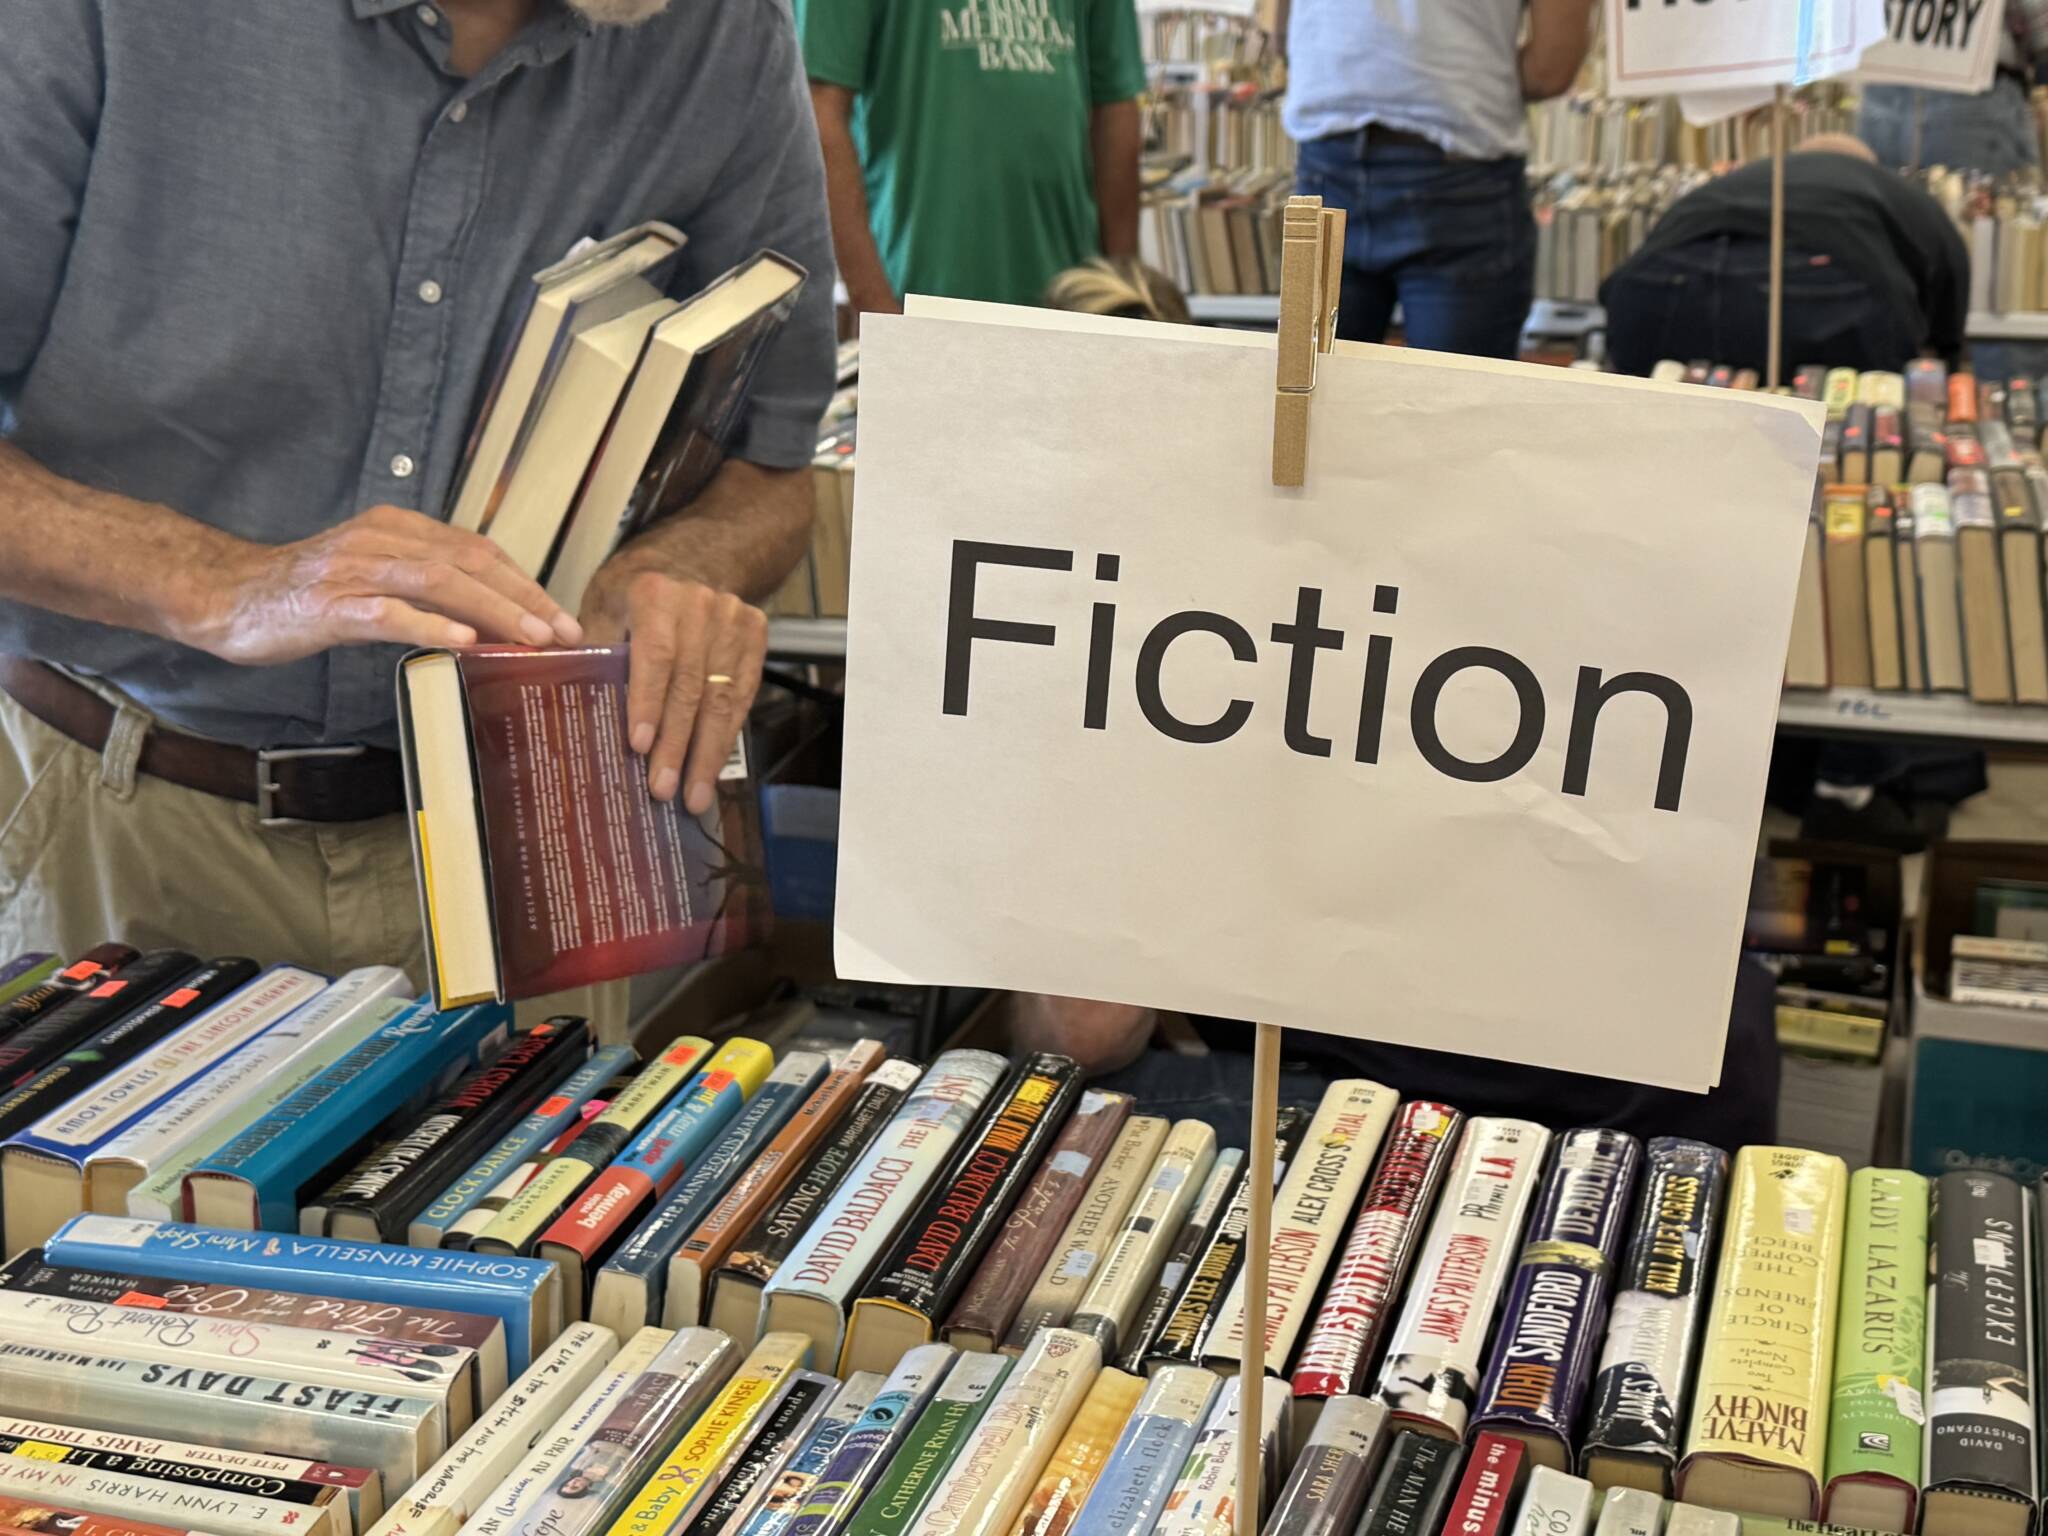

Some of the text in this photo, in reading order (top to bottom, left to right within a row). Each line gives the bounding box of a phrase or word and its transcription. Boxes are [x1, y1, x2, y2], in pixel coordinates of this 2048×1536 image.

[941, 538, 1695, 813] Fiction
[102, 1067, 160, 1108] TOWLES
[173, 1034, 204, 1059] THE
[344, 1154, 404, 1198] JAMES
[378, 1113, 464, 1168] PATTERSON
[452, 1066, 518, 1109] WORST
[500, 1035, 555, 1065] CASE
[641, 1094, 709, 1166] april may &
[983, 1114, 1034, 1153] WALK
[1004, 1098, 1044, 1125] THE
[1134, 1122, 1152, 1144] Pat
[427, 1067, 599, 1219] CLOCK DANCE TYLER
[509, 1066, 673, 1223] MUSKE-DUKES MARK TWAIN
[676, 1134, 743, 1209] MANNEQUIN
[735, 1096, 776, 1146] MAKERS
[768, 1182, 823, 1239] SAVING
[807, 1146, 849, 1188] HOPE
[840, 1107, 876, 1151] MARGARET
[869, 1086, 895, 1115] DALEY
[1110, 1136, 1143, 1171] Barker
[793, 1224, 859, 1285] DAVID
[839, 1156, 914, 1233] BALDACCI
[897, 1121, 931, 1151] THE
[924, 1075, 975, 1131] INCENT
[946, 1149, 1010, 1224] BALDACCI
[1661, 1174, 1700, 1223] CROSS
[576, 1182, 632, 1230] robin benway
[1074, 1176, 1122, 1243] ANOTHER
[1292, 1189, 1332, 1226] ALEX
[1870, 1176, 1902, 1236] LADY
[202, 1233, 531, 1280] SOPHIE KINSELLA Mini
[906, 1212, 961, 1274] DAVID
[1200, 1240, 1238, 1281] BURKE
[69, 1273, 141, 1289] HAWKER
[1187, 1272, 1218, 1303] LEE
[1268, 1226, 1322, 1314] PATTERSON
[1322, 1208, 1412, 1324] PATTERSON
[1437, 1233, 1492, 1314] PATTERSON
[1494, 1148, 1620, 1410] JOHN SANDFORD DEADLINE
[1645, 1262, 1682, 1295] KILL
[1752, 1261, 1798, 1277] THE
[1943, 1216, 2017, 1347] The EXCEPTONS
[66, 1283, 121, 1298] OLIVIA
[162, 1283, 249, 1314] Ore
[1755, 1302, 1785, 1315] OF
[1861, 1242, 1900, 1355] LAZARUS
[110, 1310, 272, 1357] Spin Robert
[303, 1299, 404, 1336] Fire
[404, 1313, 464, 1339] The
[571, 1328, 595, 1350] THE
[1164, 1295, 1208, 1347] JAMES
[1293, 1300, 1376, 1380] JAMES
[1418, 1292, 1468, 1344] JAMES
[1728, 1313, 1812, 1337] CIRCLE
[95, 1358, 127, 1373] IAN
[1729, 1357, 1797, 1377] Complete
[1738, 1347, 1790, 1364] Novels
[1746, 1369, 1775, 1384] Two
[139, 1362, 257, 1398] DAYS
[262, 1381, 406, 1420] FEAST
[719, 1376, 763, 1418] KINSEL
[1616, 1373, 1661, 1422] JAMES
[494, 1394, 527, 1428] BITCH
[776, 1389, 809, 1431] aprons
[1705, 1393, 1808, 1432] BINCHY
[1, 1421, 290, 1473] PETE DEXTER PARIS TROUT
[683, 1419, 729, 1462] SOPHIE
[759, 1431, 777, 1448] on
[1700, 1415, 1807, 1456] MAEVE
[1935, 1423, 2026, 1446] CRISTOFANO
[1958, 1437, 2004, 1452] DAVID
[63, 1448, 288, 1497] Composing a Li
[880, 1400, 974, 1520] CATHERINE RYAN HY
[924, 1425, 1014, 1527] Camberwell
[1107, 1422, 1175, 1530] elizabeth flock
[1197, 1464, 1218, 1492] Robin
[15, 1466, 269, 1520] E. LYNN HARRIS IN MY
[476, 1517, 503, 1536] AN
[530, 1460, 552, 1476] AU
[549, 1436, 576, 1459] PAIR
[635, 1485, 683, 1522] Baby
[1306, 1471, 1332, 1502] SARA
[1385, 1445, 1438, 1536] The MAN HE
[1461, 1442, 1508, 1533] the minus
[630, 1522, 650, 1533] &
